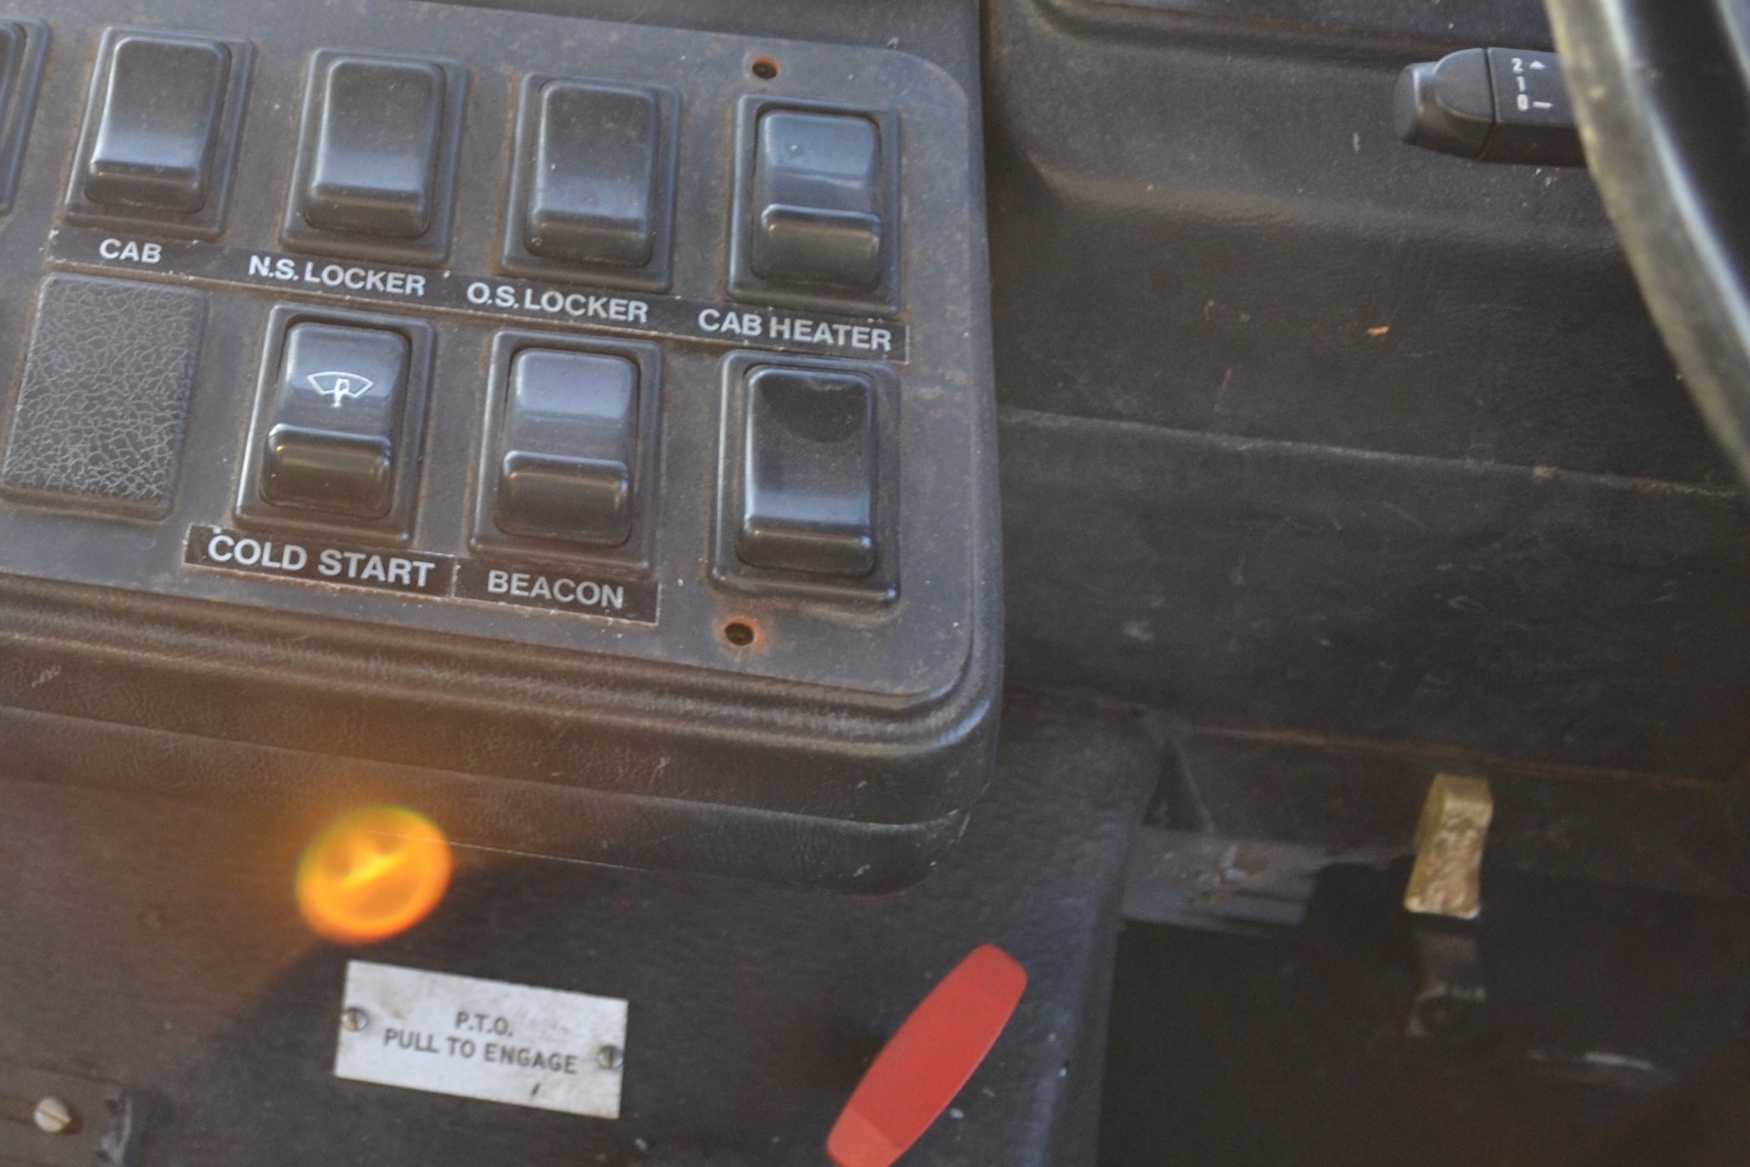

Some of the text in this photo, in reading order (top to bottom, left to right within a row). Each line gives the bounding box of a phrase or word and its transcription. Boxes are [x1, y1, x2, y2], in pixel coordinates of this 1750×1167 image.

[1510, 56, 1525, 75] 2
[1515, 75, 1527, 93] 1
[1515, 93, 1531, 113] 0
[97, 236, 163, 266] CAB
[247, 253, 427, 298] N.S. LOCKER
[465, 281, 649, 325] O.S. LOCKER
[696, 307, 893, 354] CAB HEATER
[207, 532, 436, 590] COLD START
[486, 568, 625, 611] BEACON
[453, 1009, 514, 1038] P.T.O.
[382, 1027, 578, 1075] PULL TO ENGAGE
